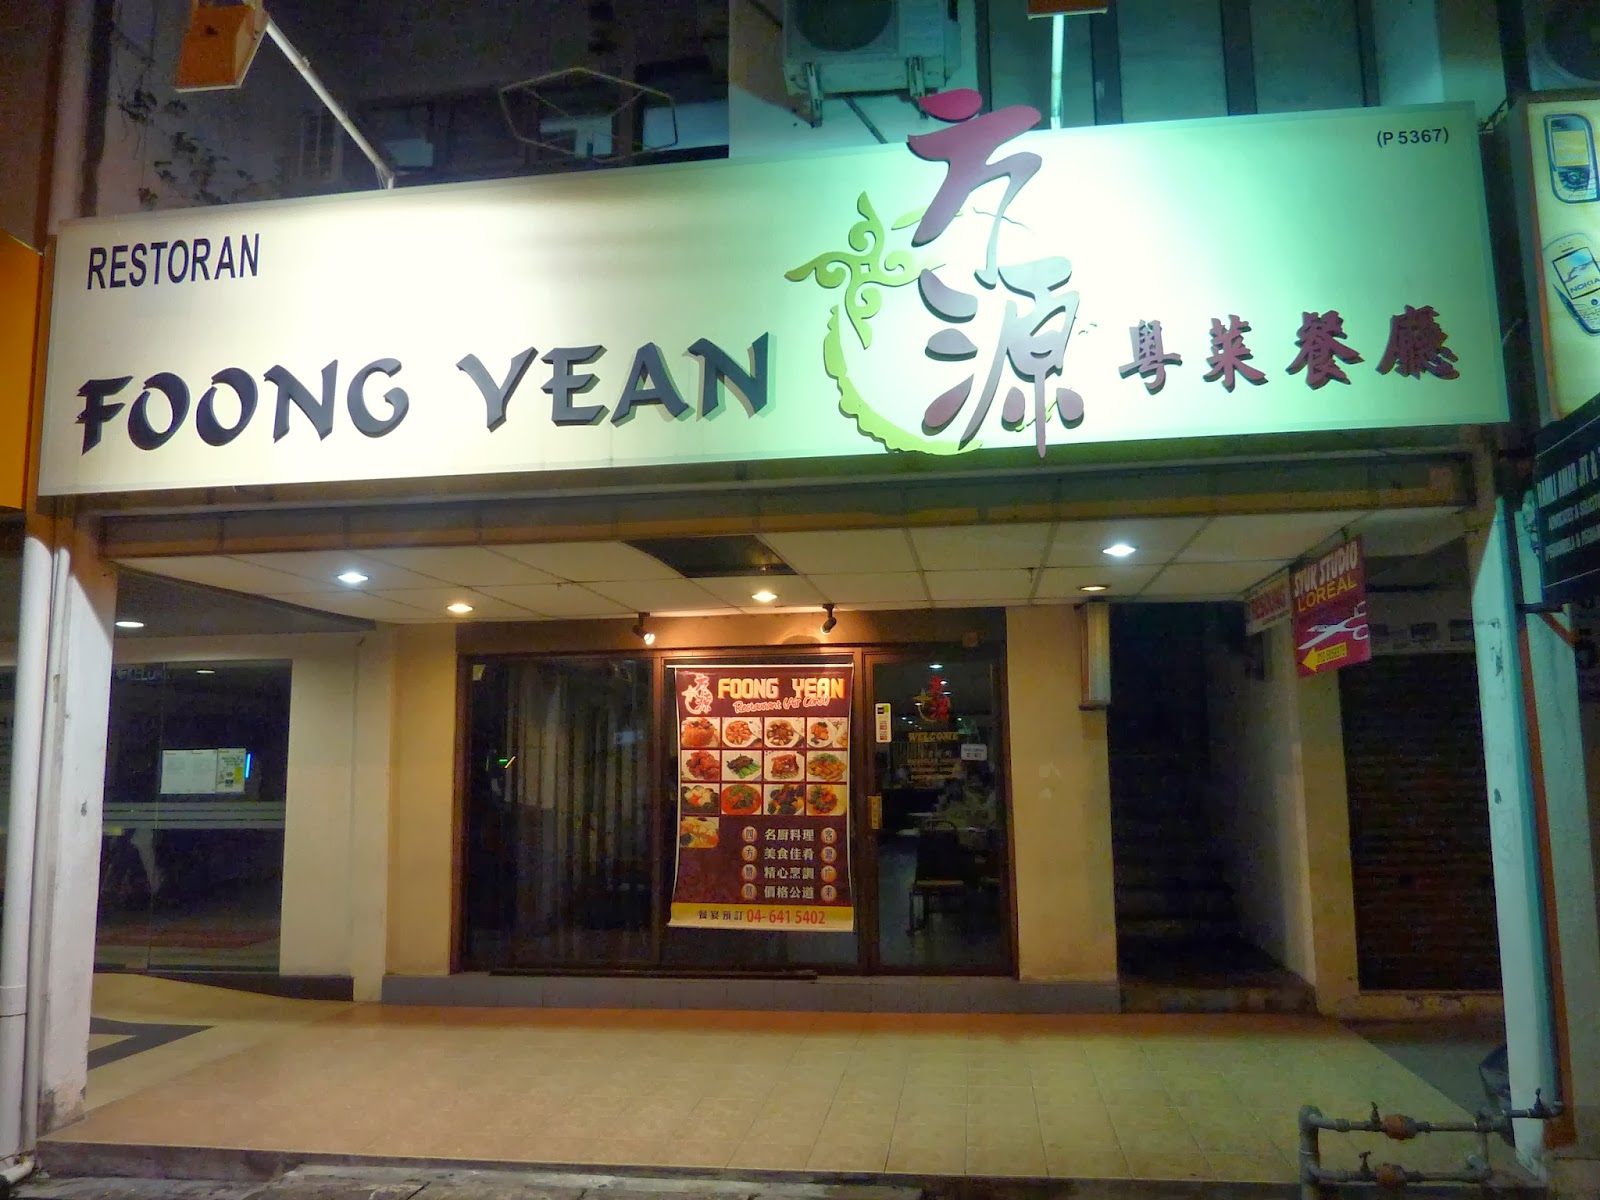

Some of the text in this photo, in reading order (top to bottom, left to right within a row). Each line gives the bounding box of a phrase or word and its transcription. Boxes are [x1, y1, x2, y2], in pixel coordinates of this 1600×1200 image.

[1377, 126, 1449, 148] (P 5367)
[86, 233, 260, 290] RESTORAN
[1570, 277, 1600, 293] NOKIA
[76, 331, 774, 455] FOONG YEAN
[718, 677, 846, 700] FOONG YEAN
